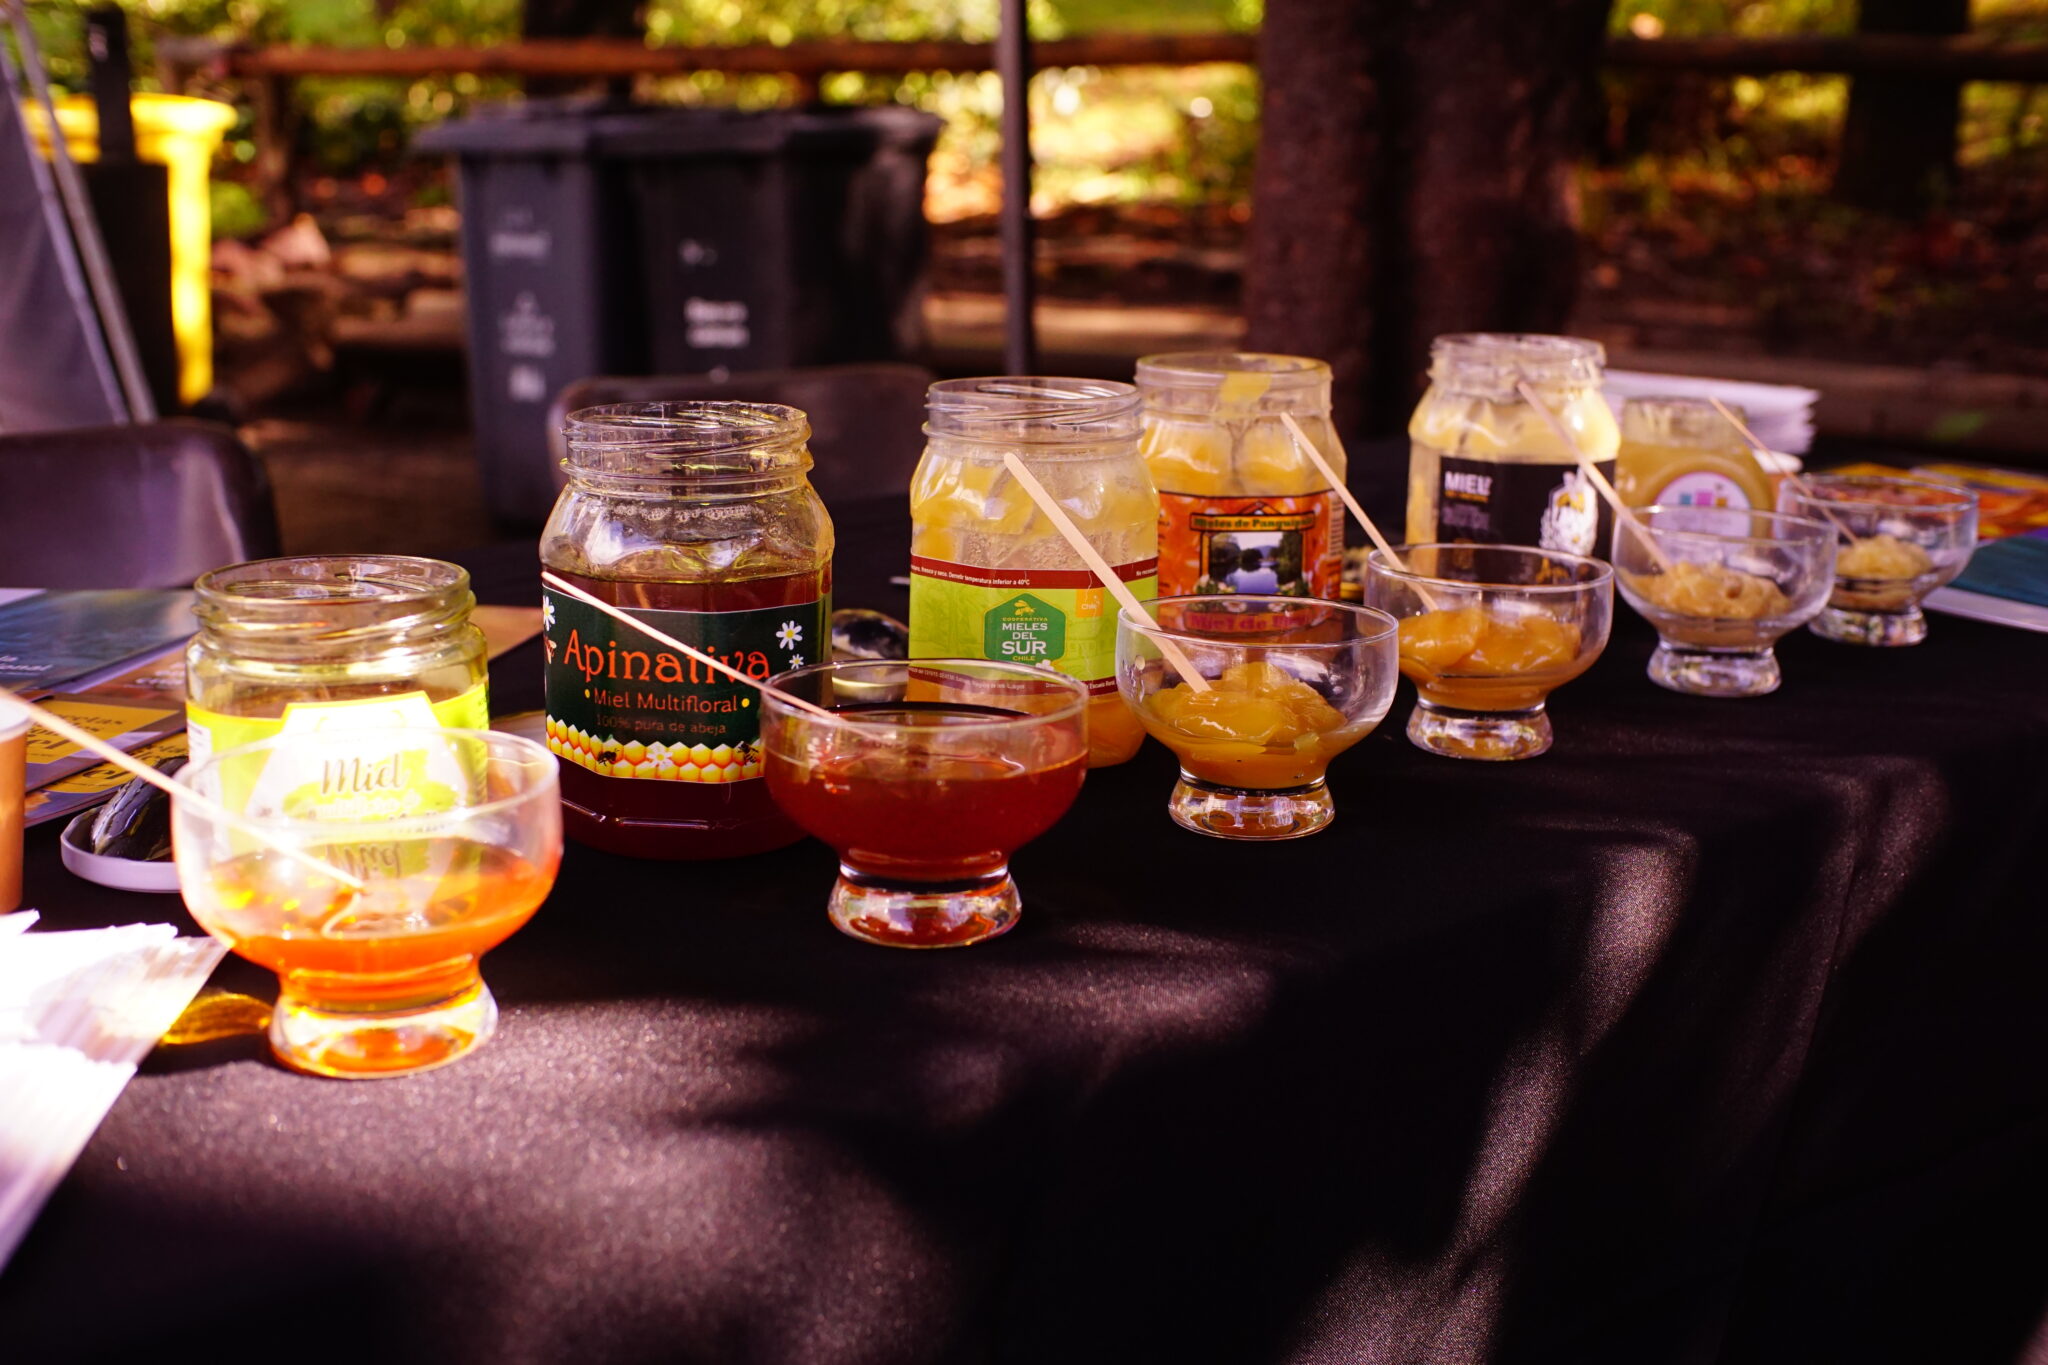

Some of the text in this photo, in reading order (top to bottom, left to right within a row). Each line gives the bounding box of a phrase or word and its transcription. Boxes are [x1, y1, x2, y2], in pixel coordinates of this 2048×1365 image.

[1235, 518, 1249, 527] de
[1002, 622, 1048, 631] MIELES
[1012, 632, 1037, 640] DEL
[563, 628, 771, 685] Apinativa
[1001, 641, 1047, 655] SUR
[594, 688, 738, 713] Miel Multifloral
[597, 714, 727, 737] 100% pura de abeja
[321, 752, 402, 794] Miel
